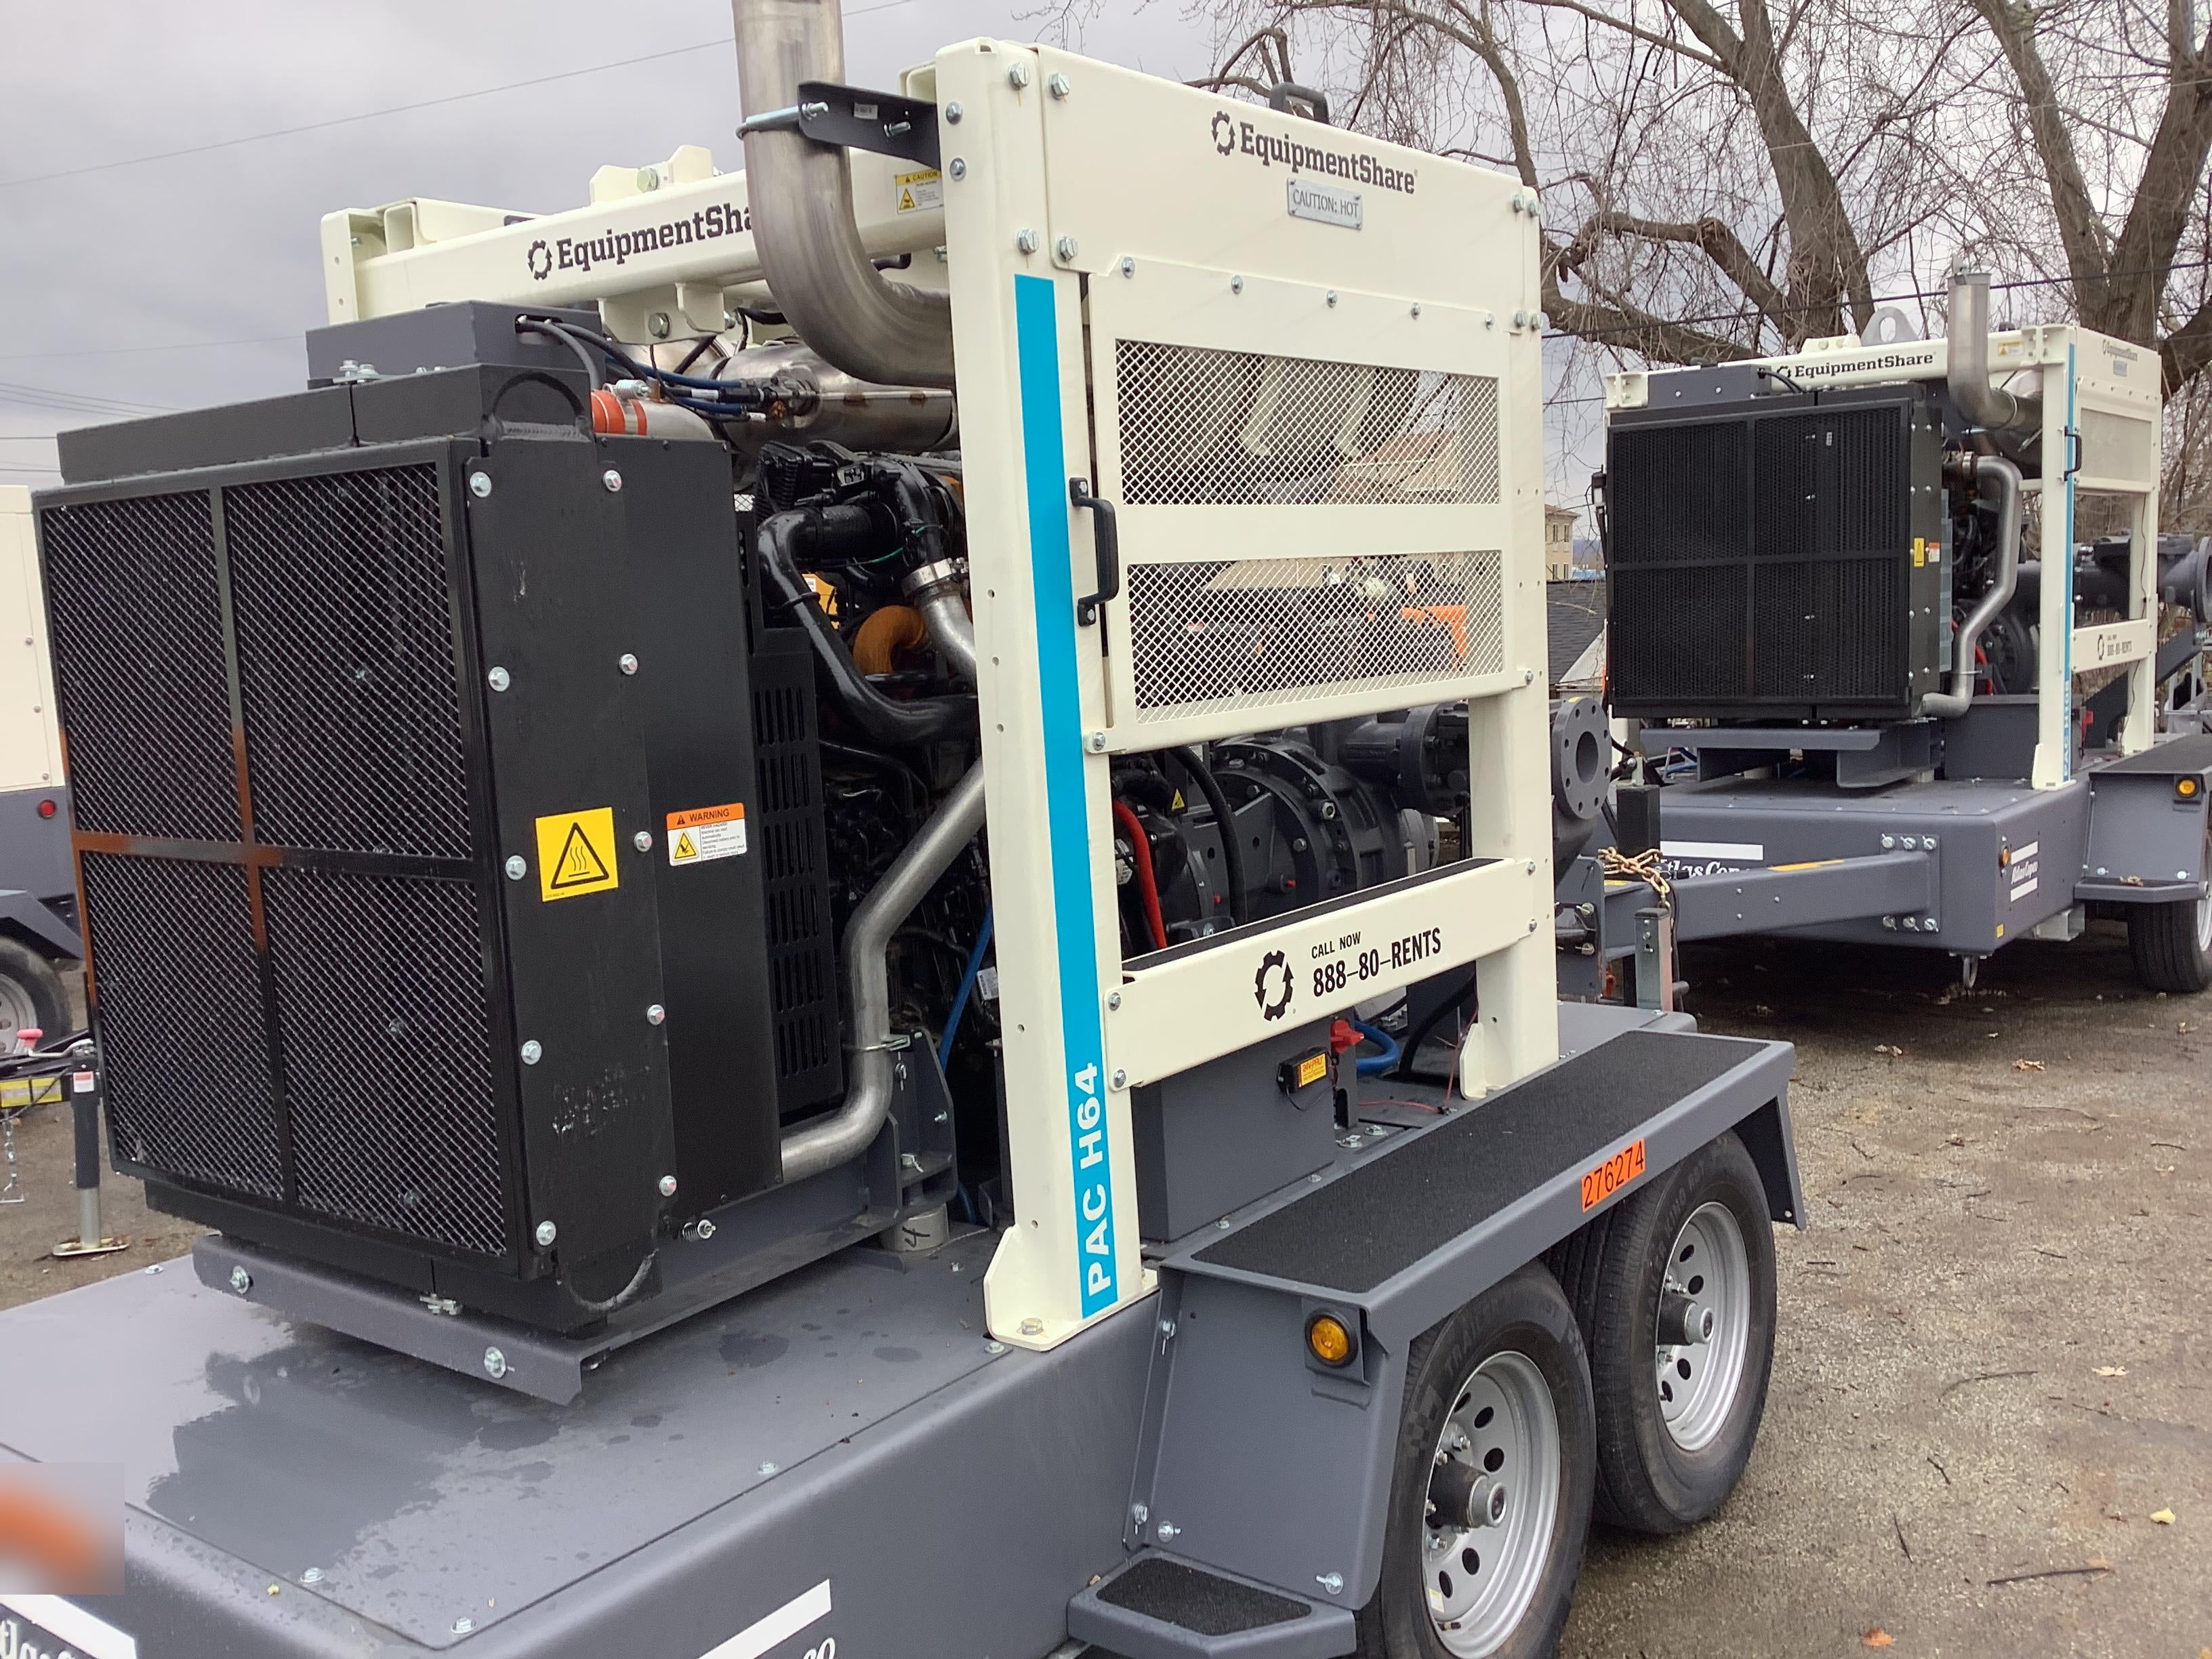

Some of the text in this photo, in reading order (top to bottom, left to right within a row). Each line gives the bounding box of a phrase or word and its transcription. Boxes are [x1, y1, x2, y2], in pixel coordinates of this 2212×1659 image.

[912, 170, 937, 181] CAUTION
[1240, 121, 1415, 194] EquipmentShare
[1292, 189, 1359, 218] CAUTION: HOT
[556, 203, 752, 272] EquipmentSha
[1795, 354, 1933, 379] EquipmentShare
[689, 808, 730, 822] WARNING
[1311, 931, 1361, 959] CALL NOW
[1313, 927, 1441, 997] 888-80-RENTS
[1075, 1061, 1111, 1297] PAC H64
[1583, 1140, 1645, 1209] 276274
